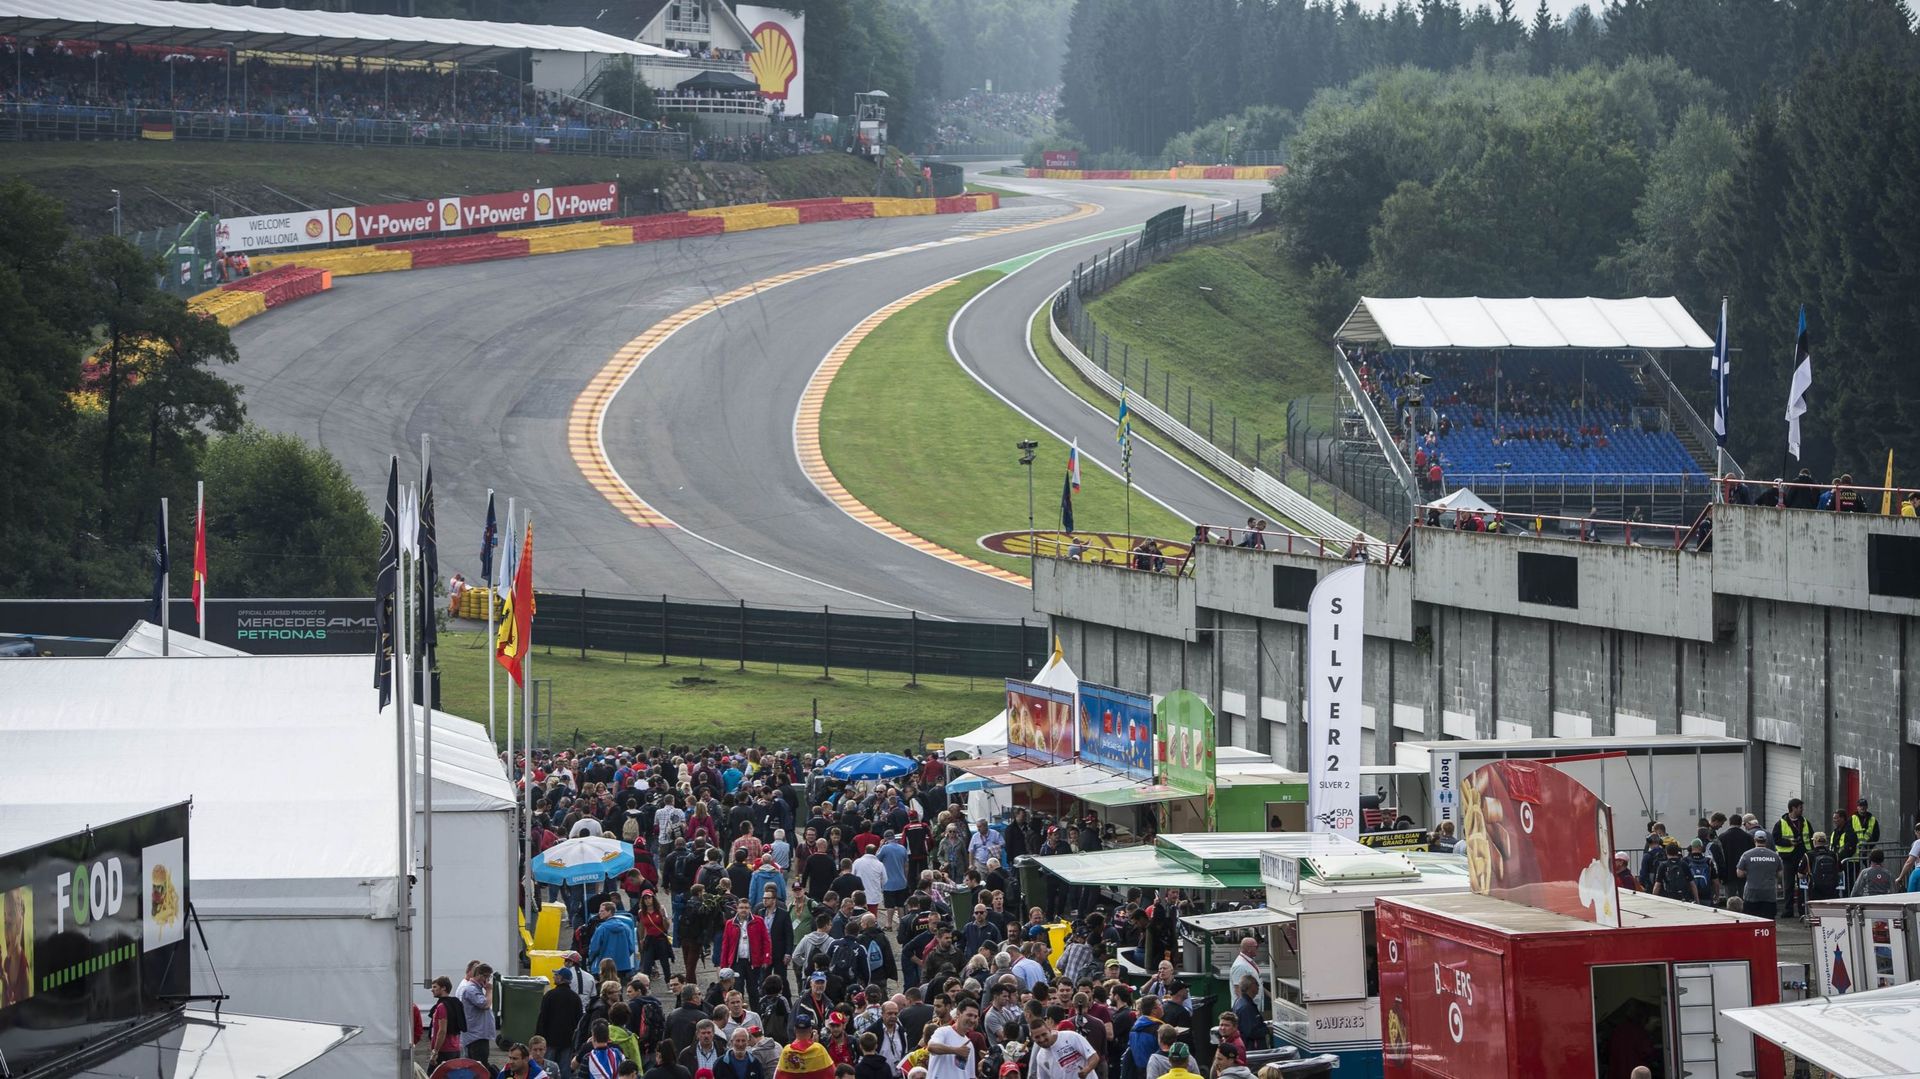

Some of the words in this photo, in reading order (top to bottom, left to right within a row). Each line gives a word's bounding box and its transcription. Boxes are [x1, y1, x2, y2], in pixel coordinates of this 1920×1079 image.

[556, 196, 614, 215] V-Power
[463, 205, 528, 225] V-Power
[249, 217, 291, 231] WELCOME
[359, 214, 432, 236] V-Power
[241, 236, 253, 247] TO
[255, 232, 299, 246] WALLONIA
[237, 618, 326, 628] MERCEDES
[237, 629, 327, 640] PETRONAS
[1319, 781, 1343, 789] SILVER
[1336, 808, 1354, 817] SPA
[1336, 817, 1354, 829] GP
[56, 856, 124, 935] FOOD
[1754, 929, 1770, 937] F10
[1433, 961, 1473, 1007] BERS
[1315, 1015, 1365, 1030] GAUFRES
